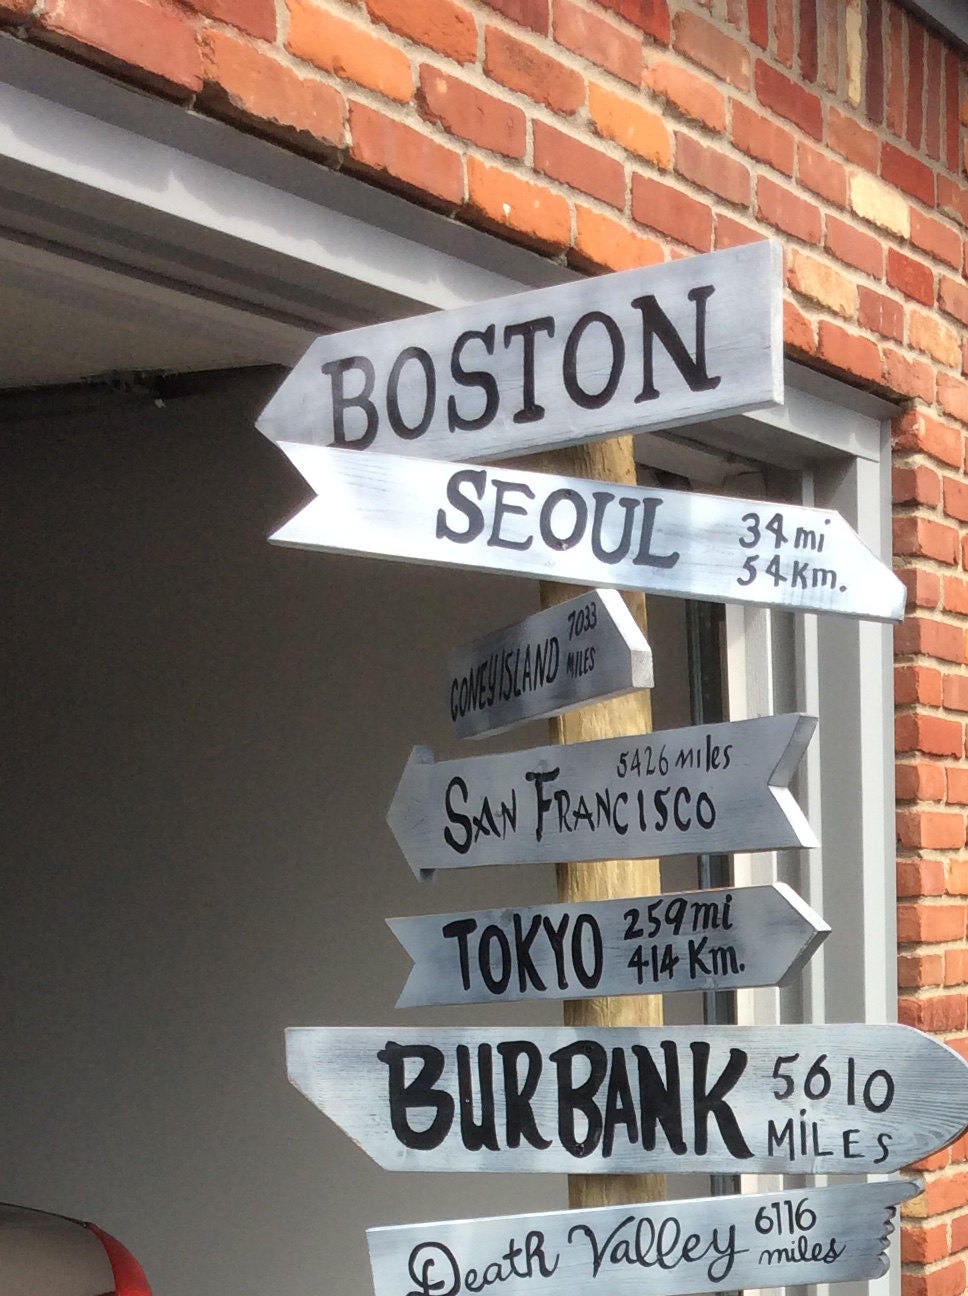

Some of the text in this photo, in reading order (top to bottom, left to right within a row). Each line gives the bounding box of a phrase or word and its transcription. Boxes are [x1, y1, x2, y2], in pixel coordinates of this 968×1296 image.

[321, 284, 722, 452] BOSTON
[435, 468, 681, 569] SEOUL
[567, 601, 598, 642] 7033
[450, 636, 560, 722] CONEY ISLAND
[566, 647, 597, 679] MILES
[616, 744, 669, 779] 5426
[443, 766, 717, 855] SAN FRANCISCO
[442, 912, 604, 995] TOKYO
[376, 1039, 756, 1160] BURBANK
[772, 1053, 896, 1114] 5610
[567, 1215, 750, 1283] Valley
[755, 1197, 817, 1236] 6116
[758, 1234, 847, 1266] miles
